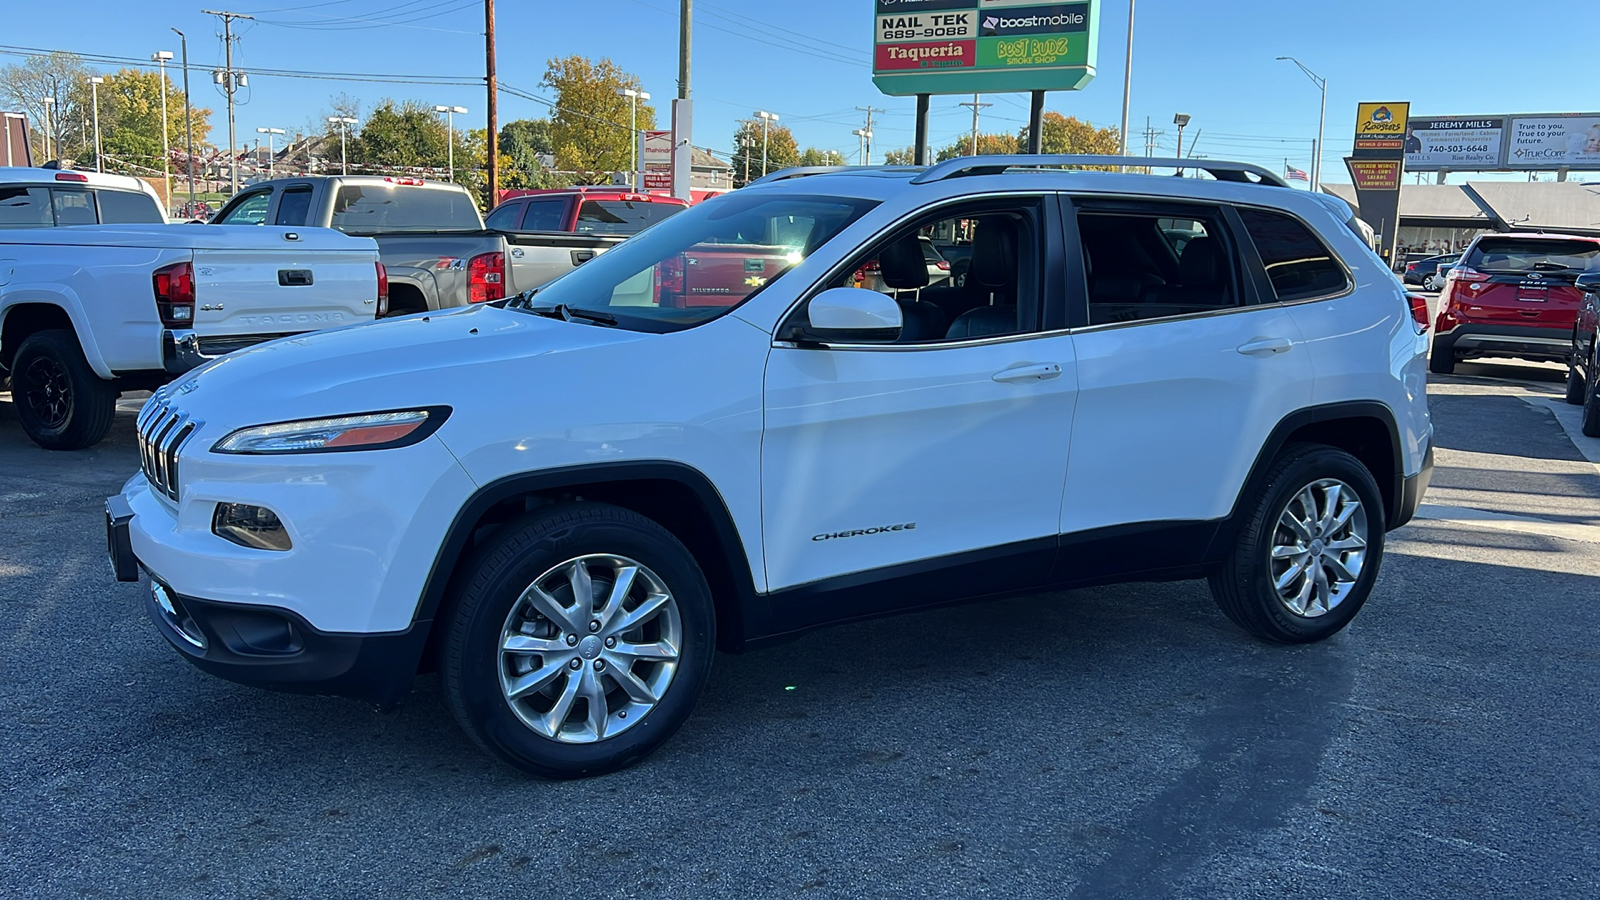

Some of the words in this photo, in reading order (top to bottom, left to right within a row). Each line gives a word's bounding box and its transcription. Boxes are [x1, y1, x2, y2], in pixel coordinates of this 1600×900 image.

[882, 17, 922, 29] NAIL
[931, 13, 968, 26] TEK
[1000, 13, 1084, 28] boostmobile
[884, 27, 967, 39] 689-9088
[1031, 37, 1068, 57] BUDZ
[1007, 57, 1033, 65] SMOKE
[1034, 56, 1056, 64] SHOP
[1362, 120, 1401, 132] Roosters
[1466, 120, 1492, 128] MILLS
[1547, 130, 1566, 138] your
[1428, 145, 1488, 153] 740-503-6648
[1466, 153, 1484, 162] Realty
[239, 312, 345, 326] TACOMA
[811, 522, 917, 542] CHEROKEE
